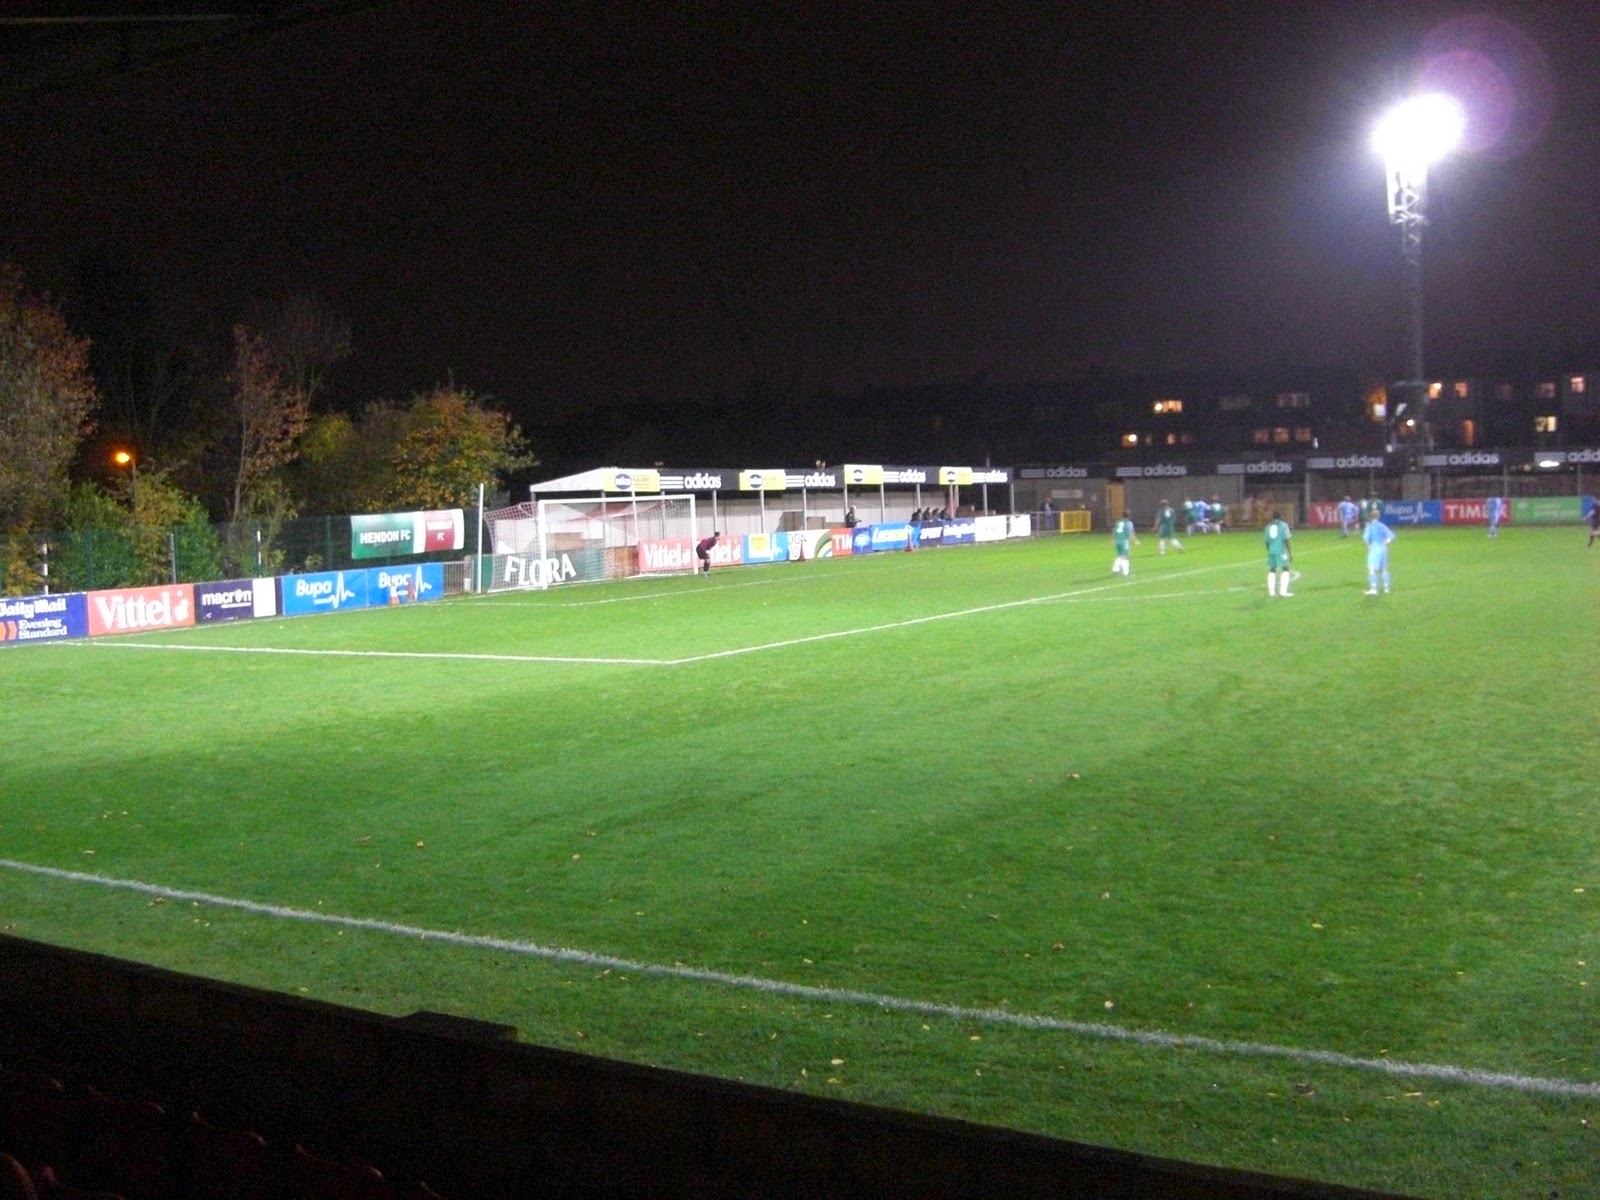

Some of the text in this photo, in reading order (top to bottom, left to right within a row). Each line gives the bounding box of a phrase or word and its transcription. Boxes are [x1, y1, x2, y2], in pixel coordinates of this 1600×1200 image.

[1336, 456, 1384, 468] adidas
[1450, 453, 1499, 465] adidas
[1568, 449, 1600, 462] adid
[1047, 466, 1087, 478] adidas
[1144, 464, 1187, 476] adidas
[1247, 461, 1292, 473] adidas
[684, 473, 722, 489] adidas
[805, 472, 835, 487] adidas
[900, 469, 926, 483] adidas
[360, 529, 411, 544] HENDON FC
[504, 553, 577, 586] FLORA
[296, 580, 332, 598] Bupa
[95, 591, 172, 630] Vittel
[19, 618, 62, 630] Evening
[19, 625, 67, 639] Standard
